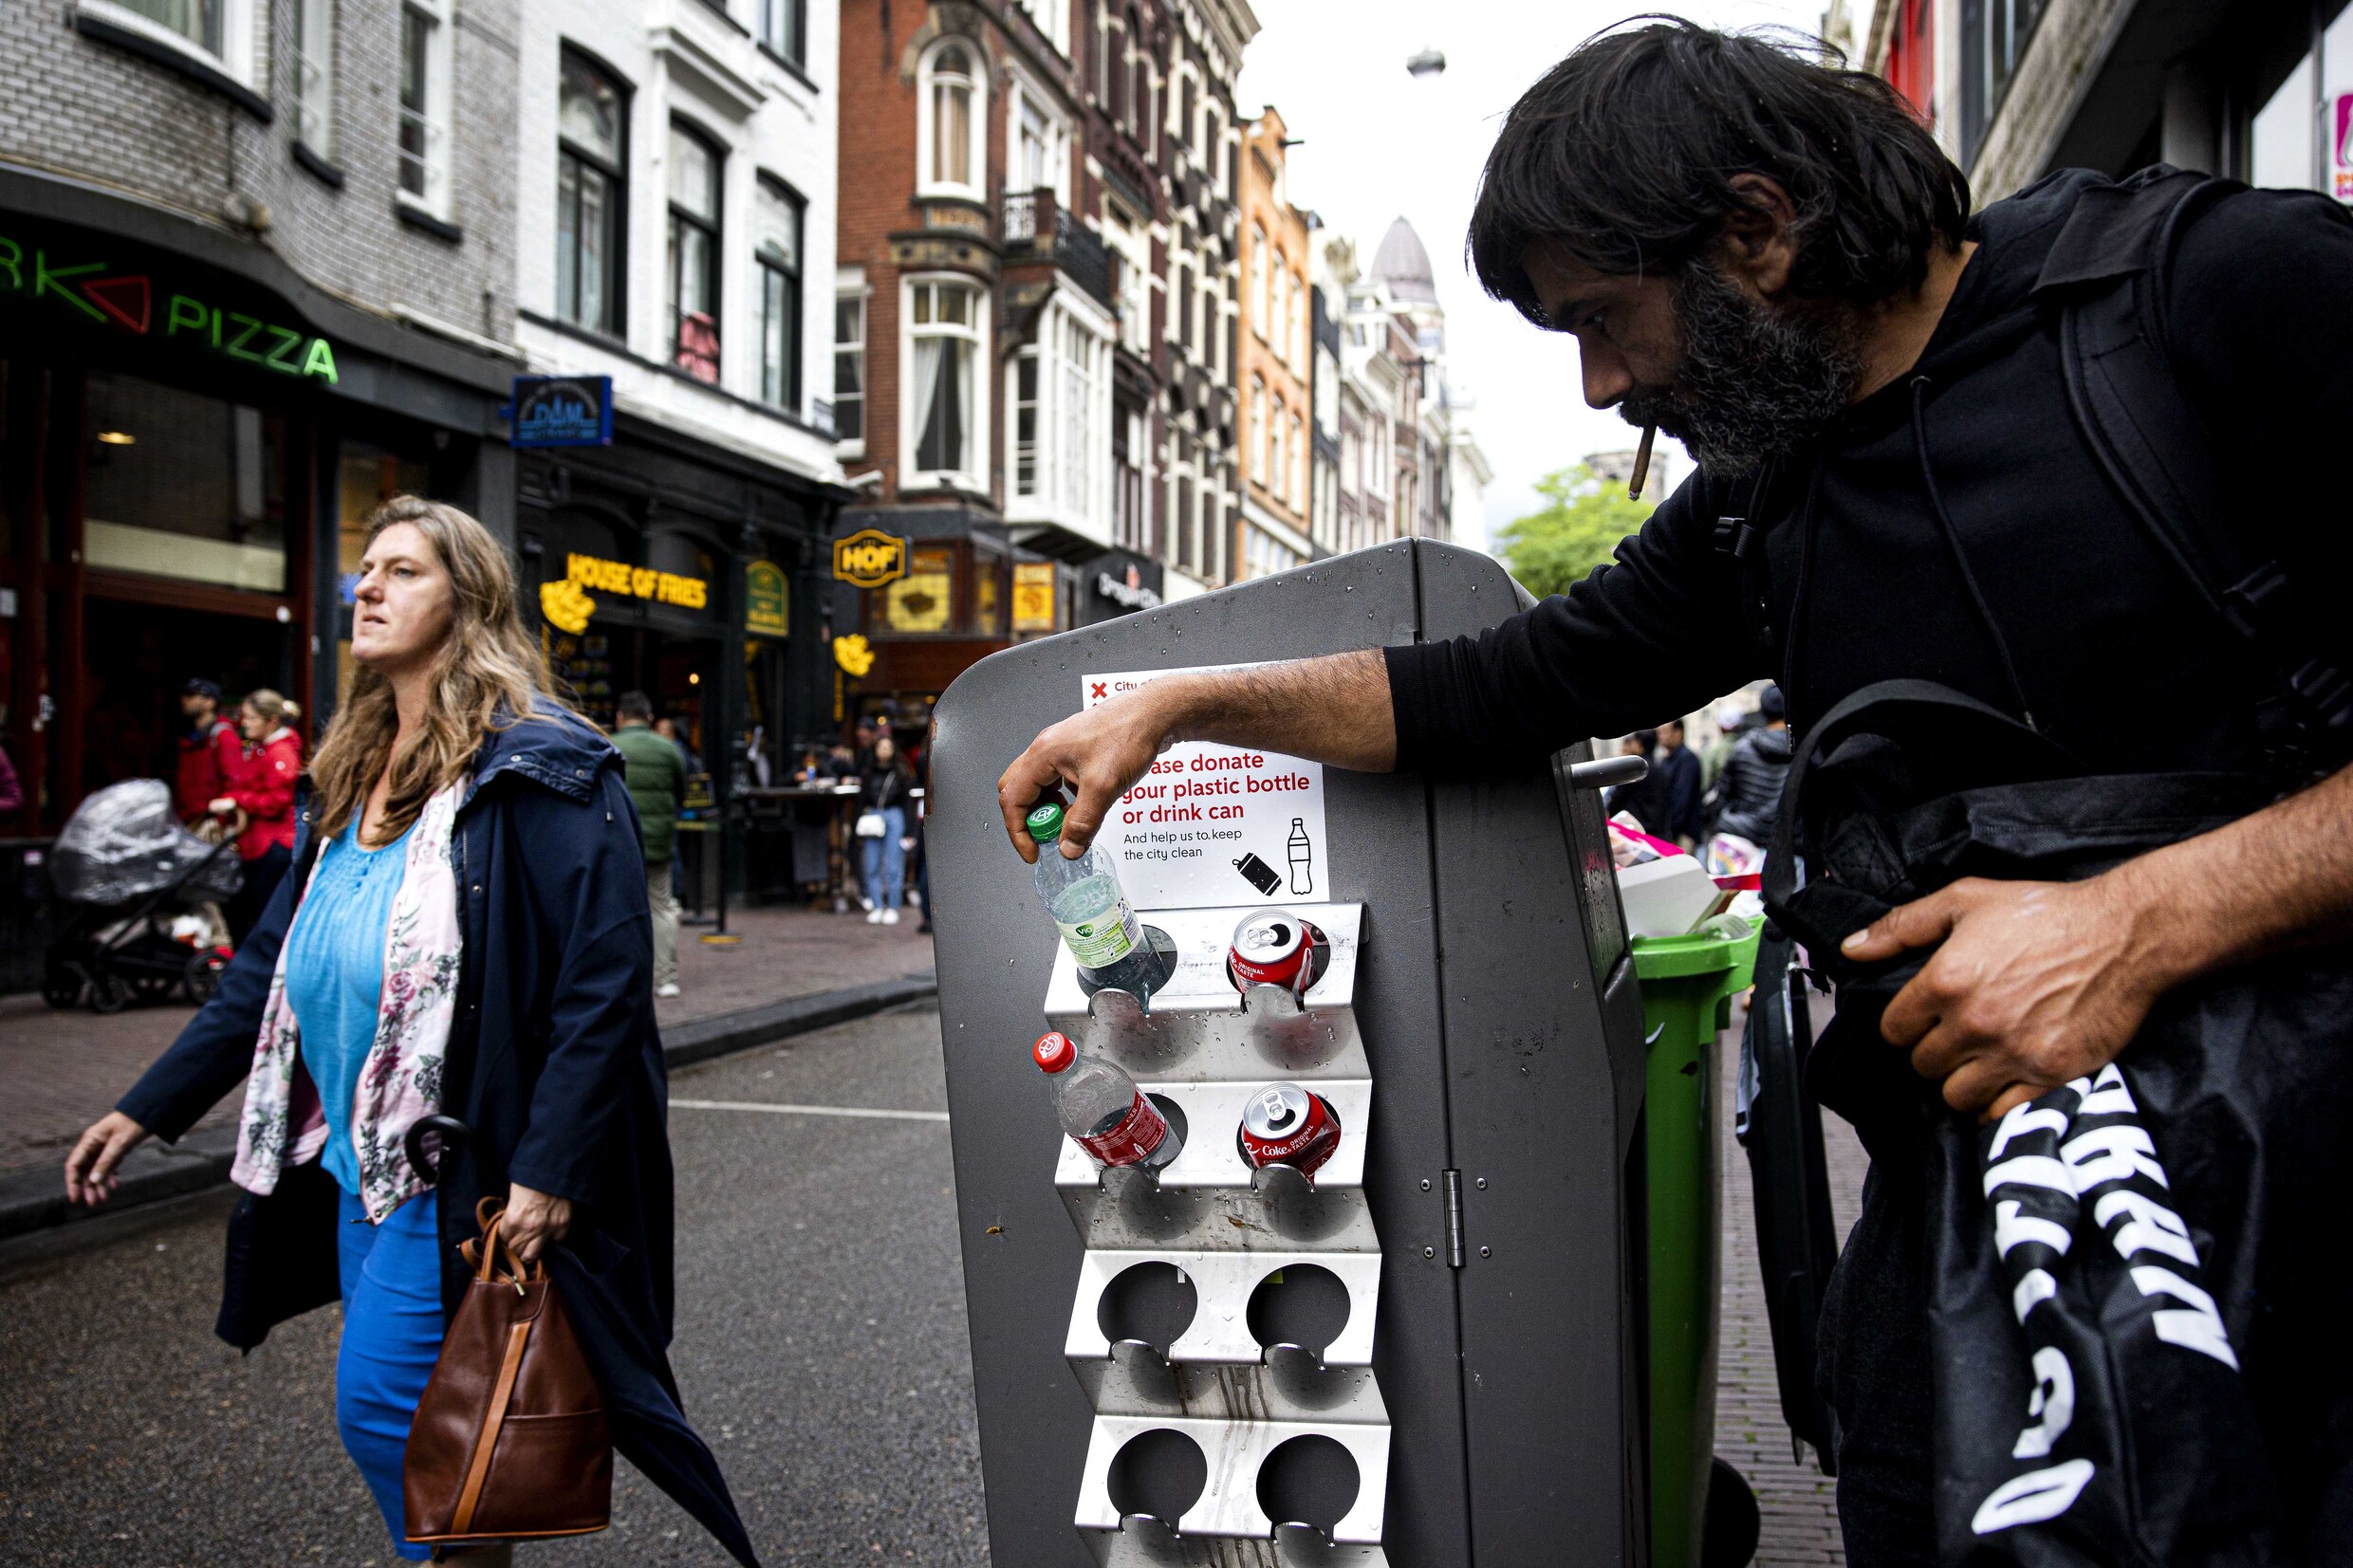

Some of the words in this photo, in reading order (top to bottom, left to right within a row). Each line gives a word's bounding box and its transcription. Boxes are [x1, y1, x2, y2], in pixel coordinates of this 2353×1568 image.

[167, 293, 339, 384] PIZZA
[842, 544, 898, 571] HOF
[567, 552, 632, 595] HOUSE
[632, 567, 658, 600] OF
[658, 572, 707, 609] FRIES
[1191, 752, 1264, 772] donate
[1122, 784, 1167, 804] your
[1174, 777, 1240, 801] plastic
[1247, 771, 1310, 793] bottle
[1122, 810, 1144, 824] or
[1150, 803, 1203, 822] drink
[1209, 804, 1245, 820] can
[1123, 830, 1147, 844] And
[1151, 830, 1177, 846] help
[1180, 832, 1194, 841] us
[1196, 830, 1209, 841] to
[1212, 828, 1243, 842] keep
[1124, 848, 1144, 860] the
[1146, 847, 1168, 861] city
[1171, 846, 1203, 858] clean
[1237, 967, 1254, 978] TASTE
[1238, 961, 1265, 975] ORIGINAL
[1262, 1145, 1288, 1156] Coke
[1289, 1124, 1314, 1146] ORIGINAL
[1291, 1136, 1310, 1151] TASTE
